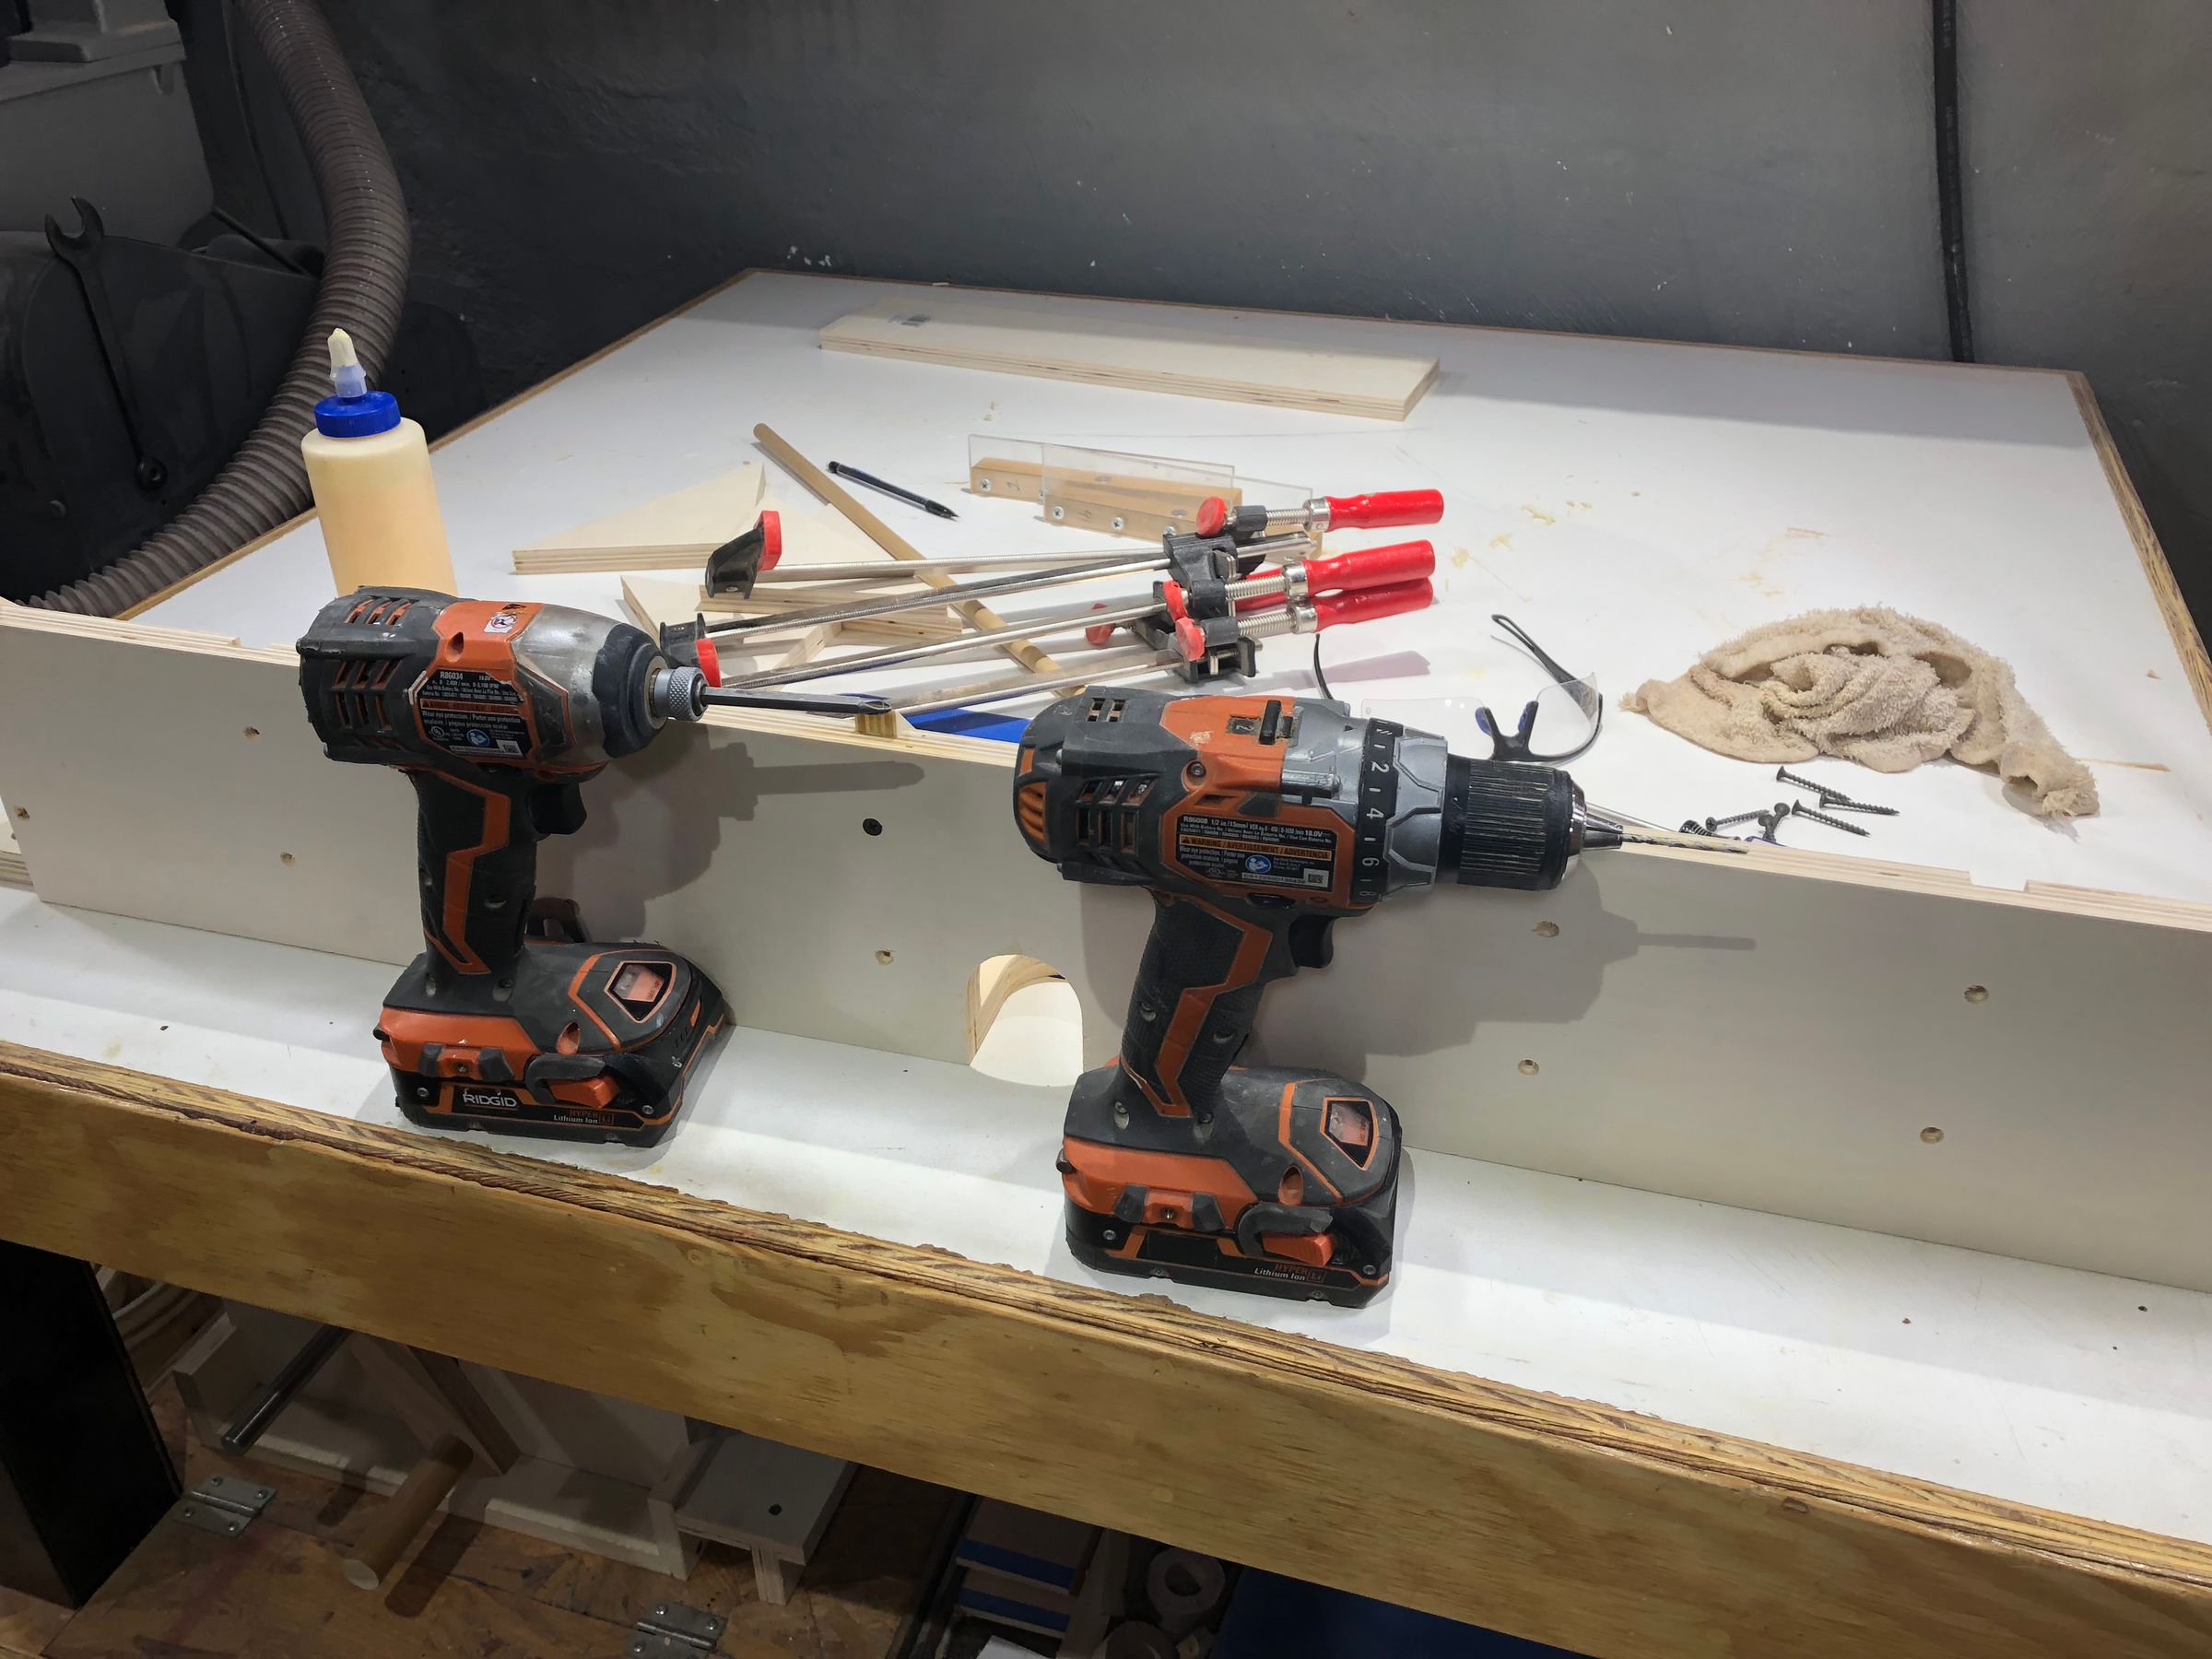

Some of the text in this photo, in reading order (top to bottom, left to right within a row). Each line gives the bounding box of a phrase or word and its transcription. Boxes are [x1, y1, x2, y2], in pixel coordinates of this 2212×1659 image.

[441, 671, 464, 680] R86034
[1371, 761, 1389, 773] 2
[1366, 807, 1384, 819] 4
[1191, 838, 1222, 848] WARNING
[1227, 841, 1278, 854] AVERTISSEMENT
[1361, 857, 1380, 866] 6
[463, 1090, 518, 1108] RIDGID
[554, 1114, 583, 1124] Lithium
[570, 1109, 598, 1118] HYPER
[1254, 1267, 1306, 1281] Lithium Ion
[1275, 1263, 1307, 1274] HYPER
